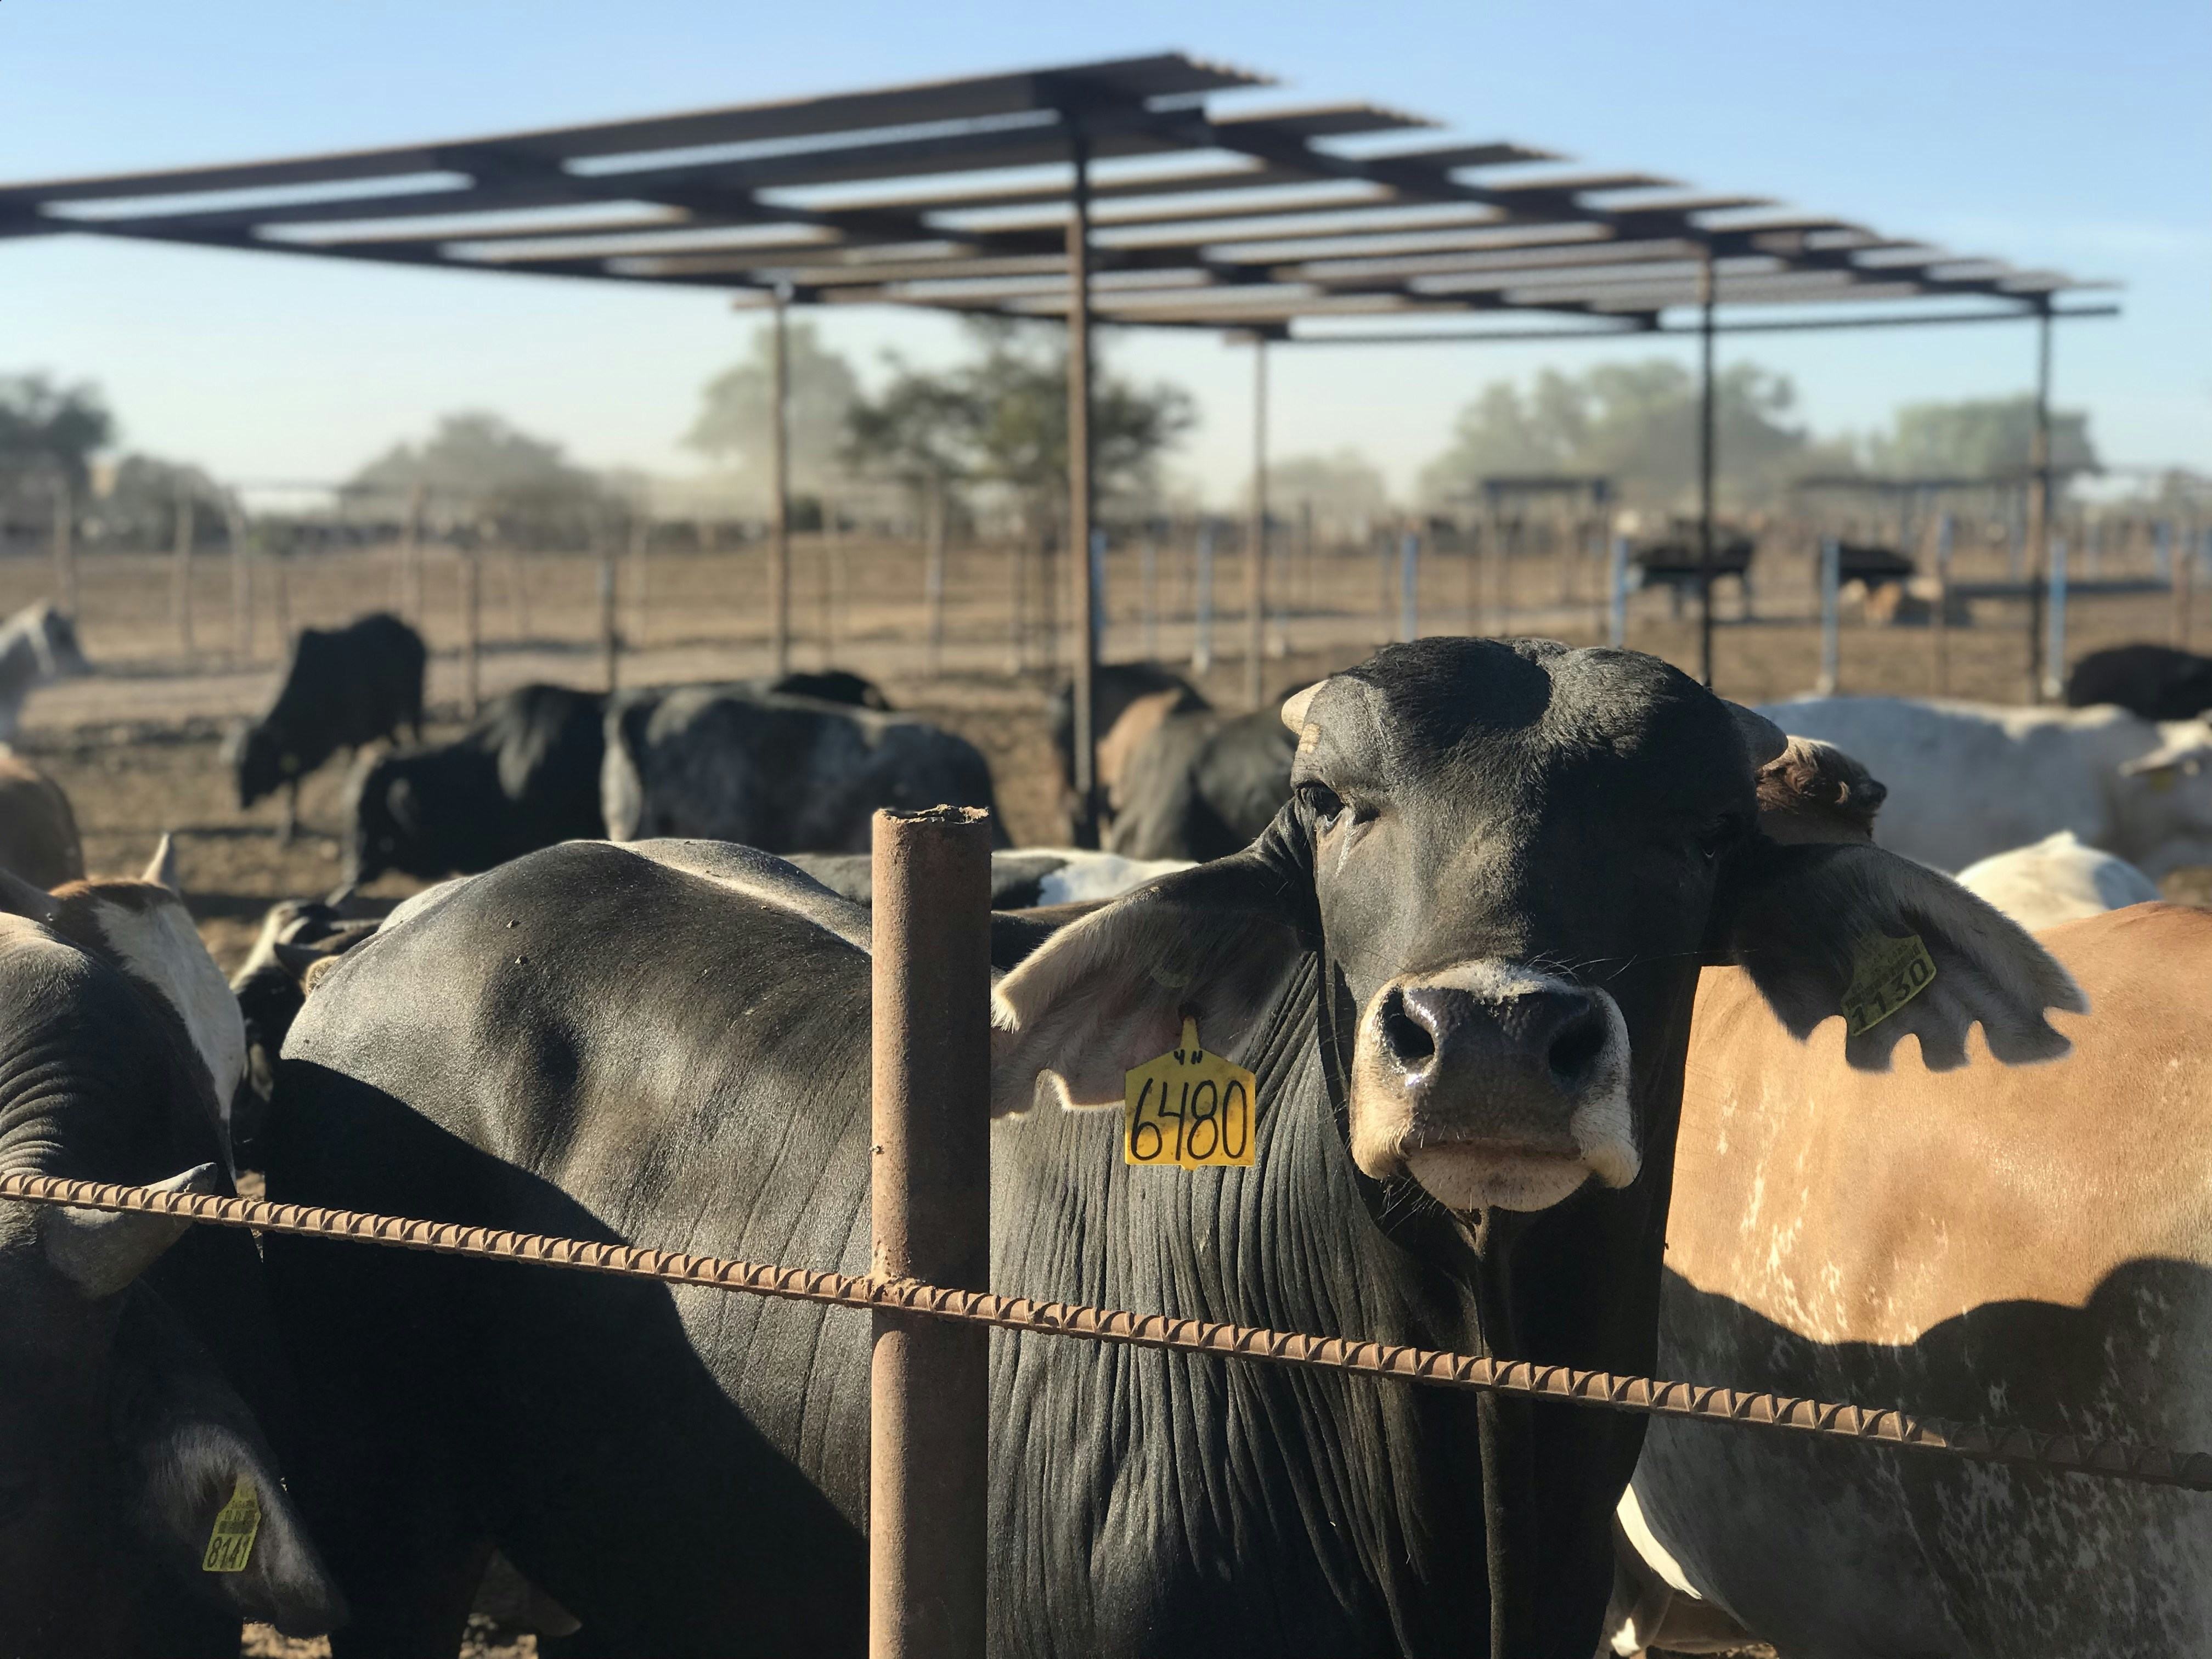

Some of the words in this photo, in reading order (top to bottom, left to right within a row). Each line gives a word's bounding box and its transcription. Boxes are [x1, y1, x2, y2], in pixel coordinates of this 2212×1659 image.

[1852, 958, 1929, 1032] 1130
[1131, 1077, 1247, 1161] 6480
[207, 1534, 251, 1569] 8141
